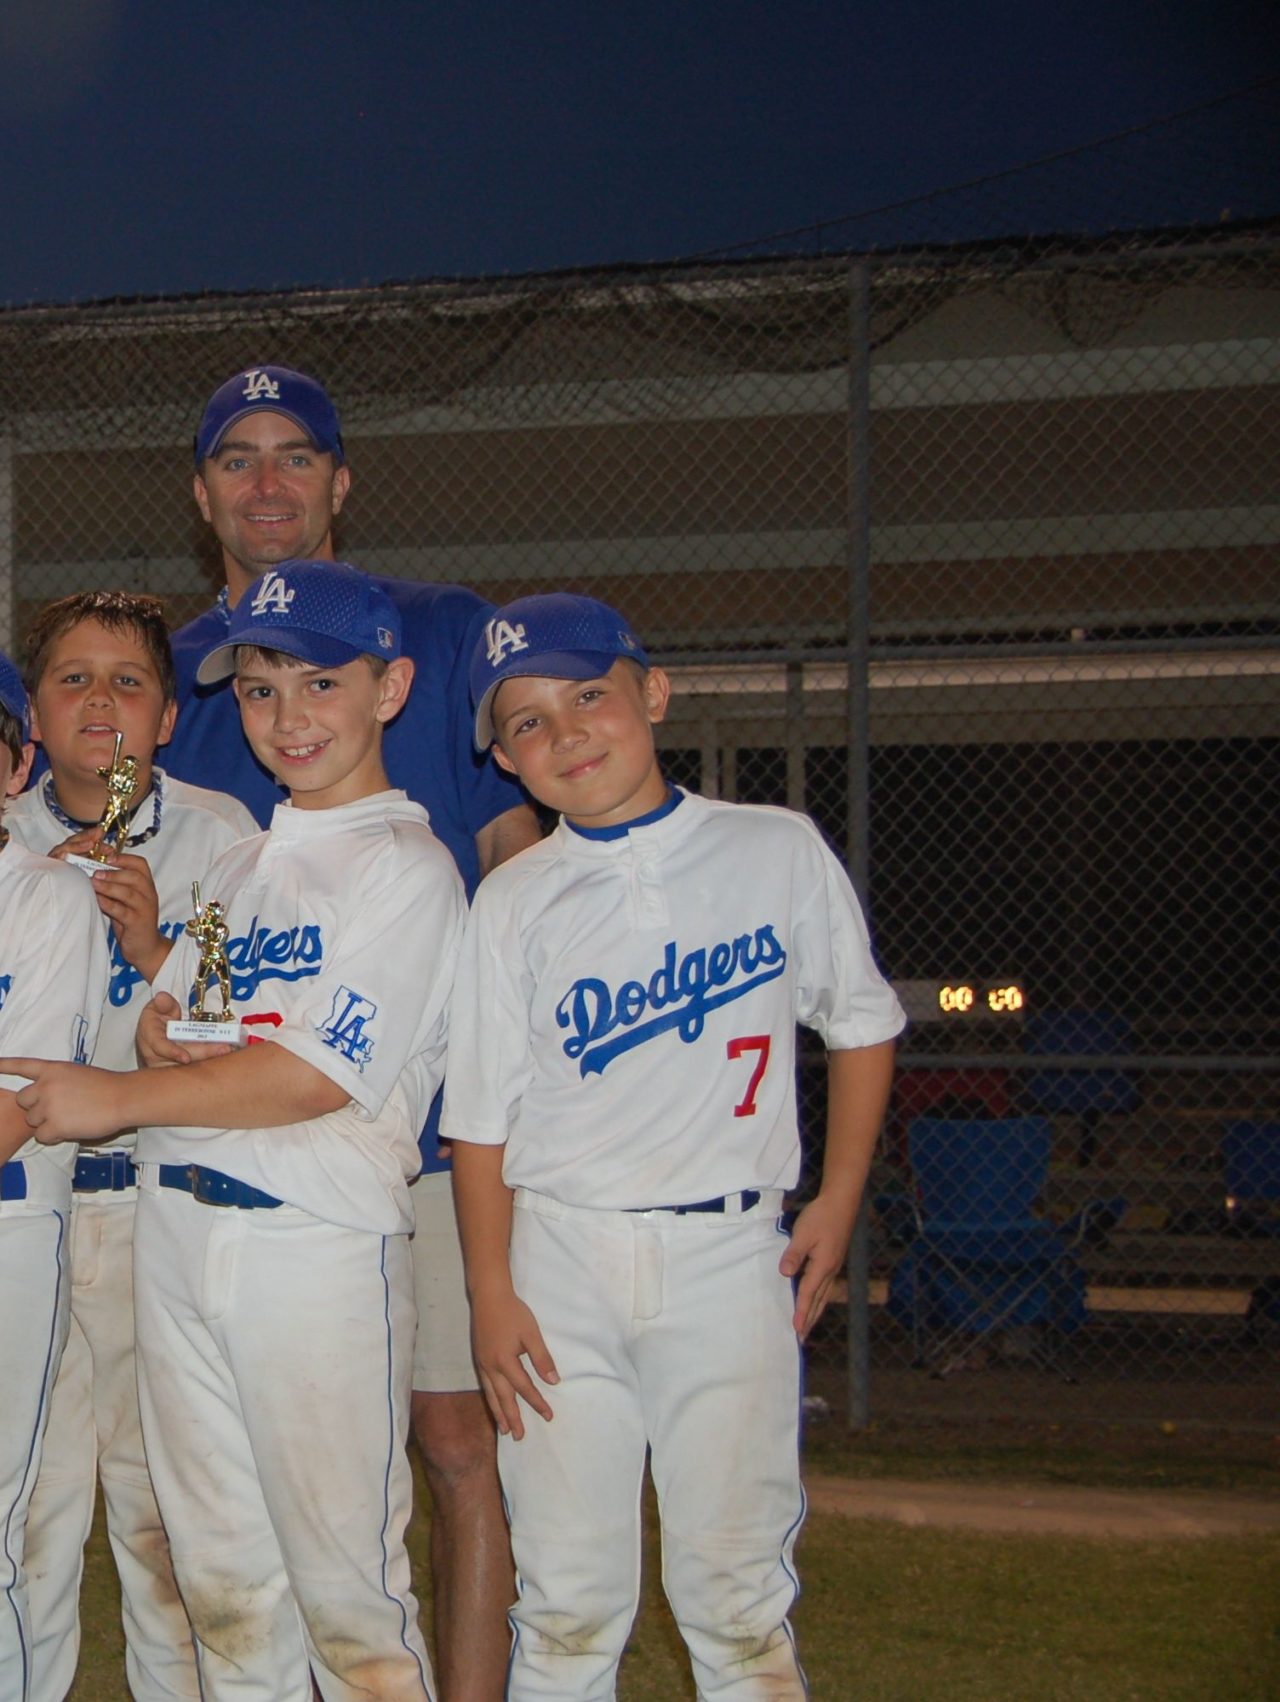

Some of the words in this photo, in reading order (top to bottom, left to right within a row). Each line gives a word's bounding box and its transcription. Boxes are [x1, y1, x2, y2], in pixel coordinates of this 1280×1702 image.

[242, 370, 280, 401] LA
[251, 571, 296, 616] LA
[486, 618, 529, 667] LA
[556, 924, 787, 1060] Dodgers
[322, 992, 369, 1063] LA
[727, 1034, 771, 1117] 7
